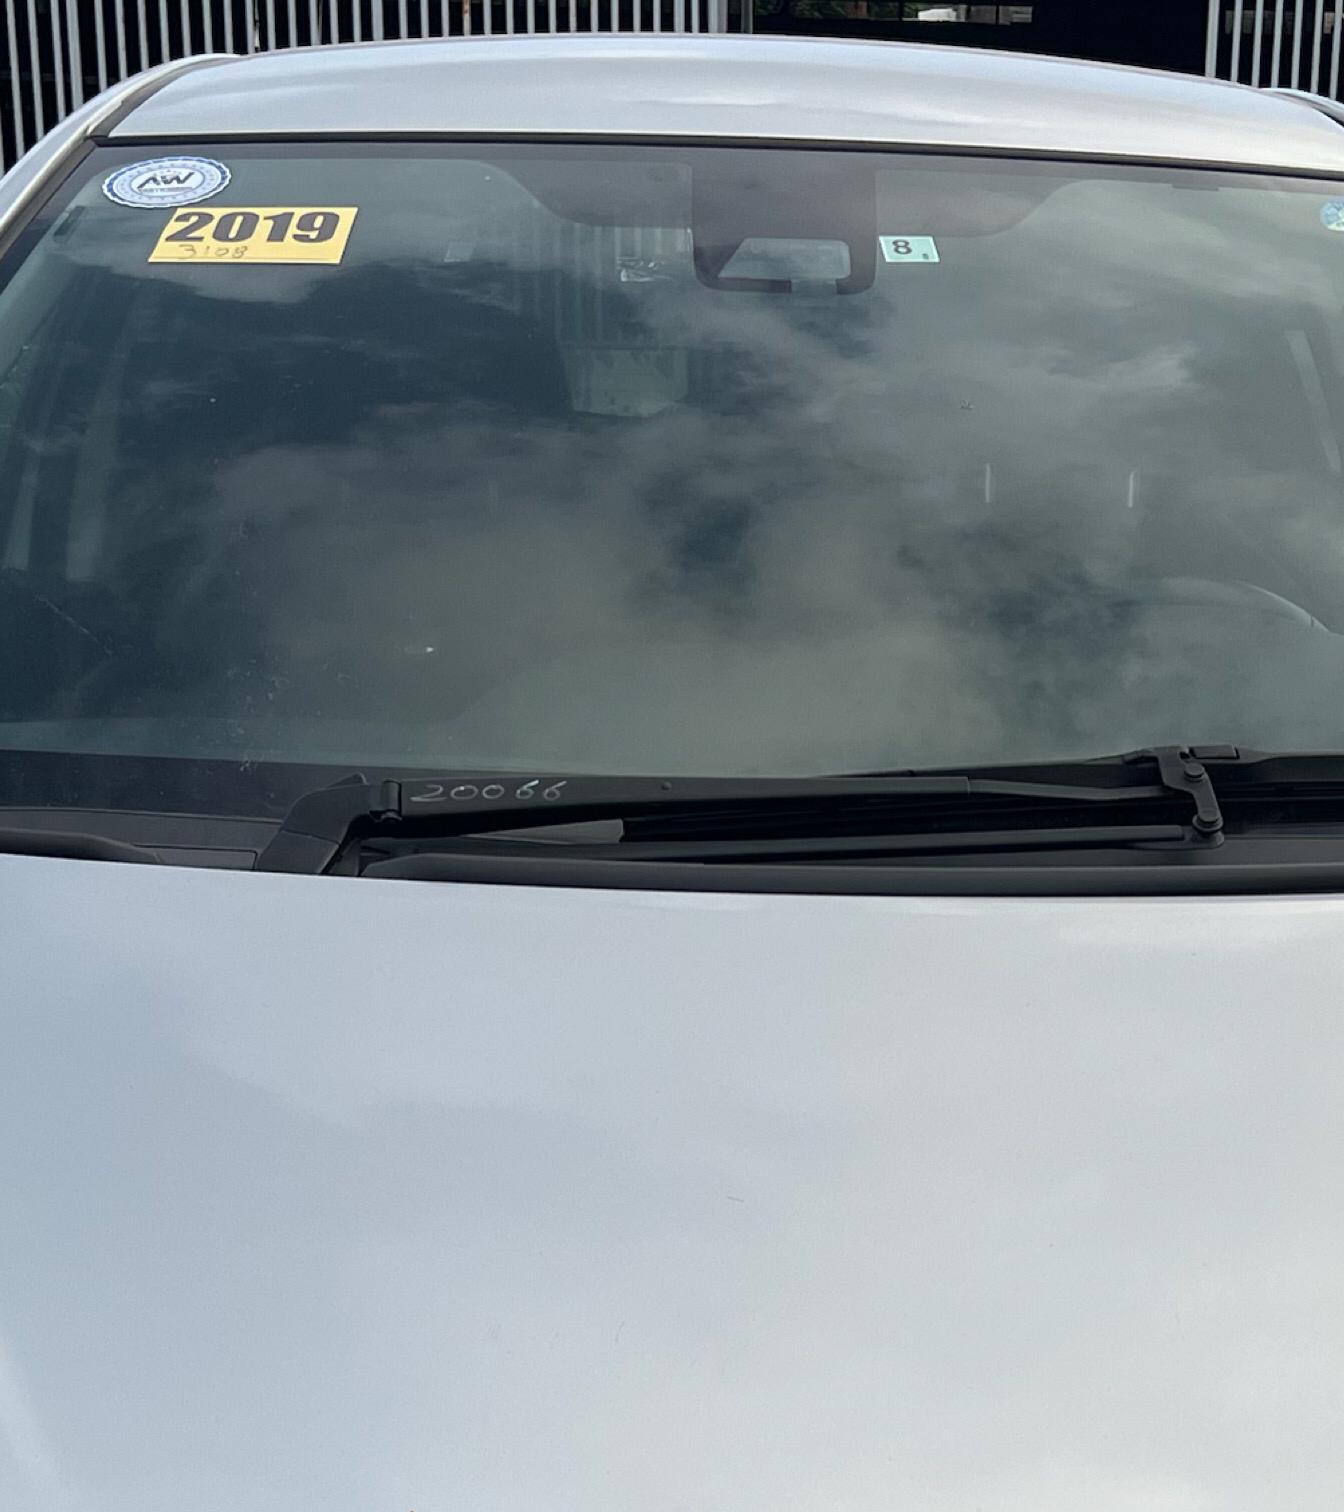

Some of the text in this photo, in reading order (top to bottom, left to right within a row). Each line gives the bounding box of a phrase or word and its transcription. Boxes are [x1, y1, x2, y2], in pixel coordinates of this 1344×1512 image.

[164, 211, 340, 243] 2019
[892, 239, 913, 255] 8
[411, 779, 567, 802] 20066
